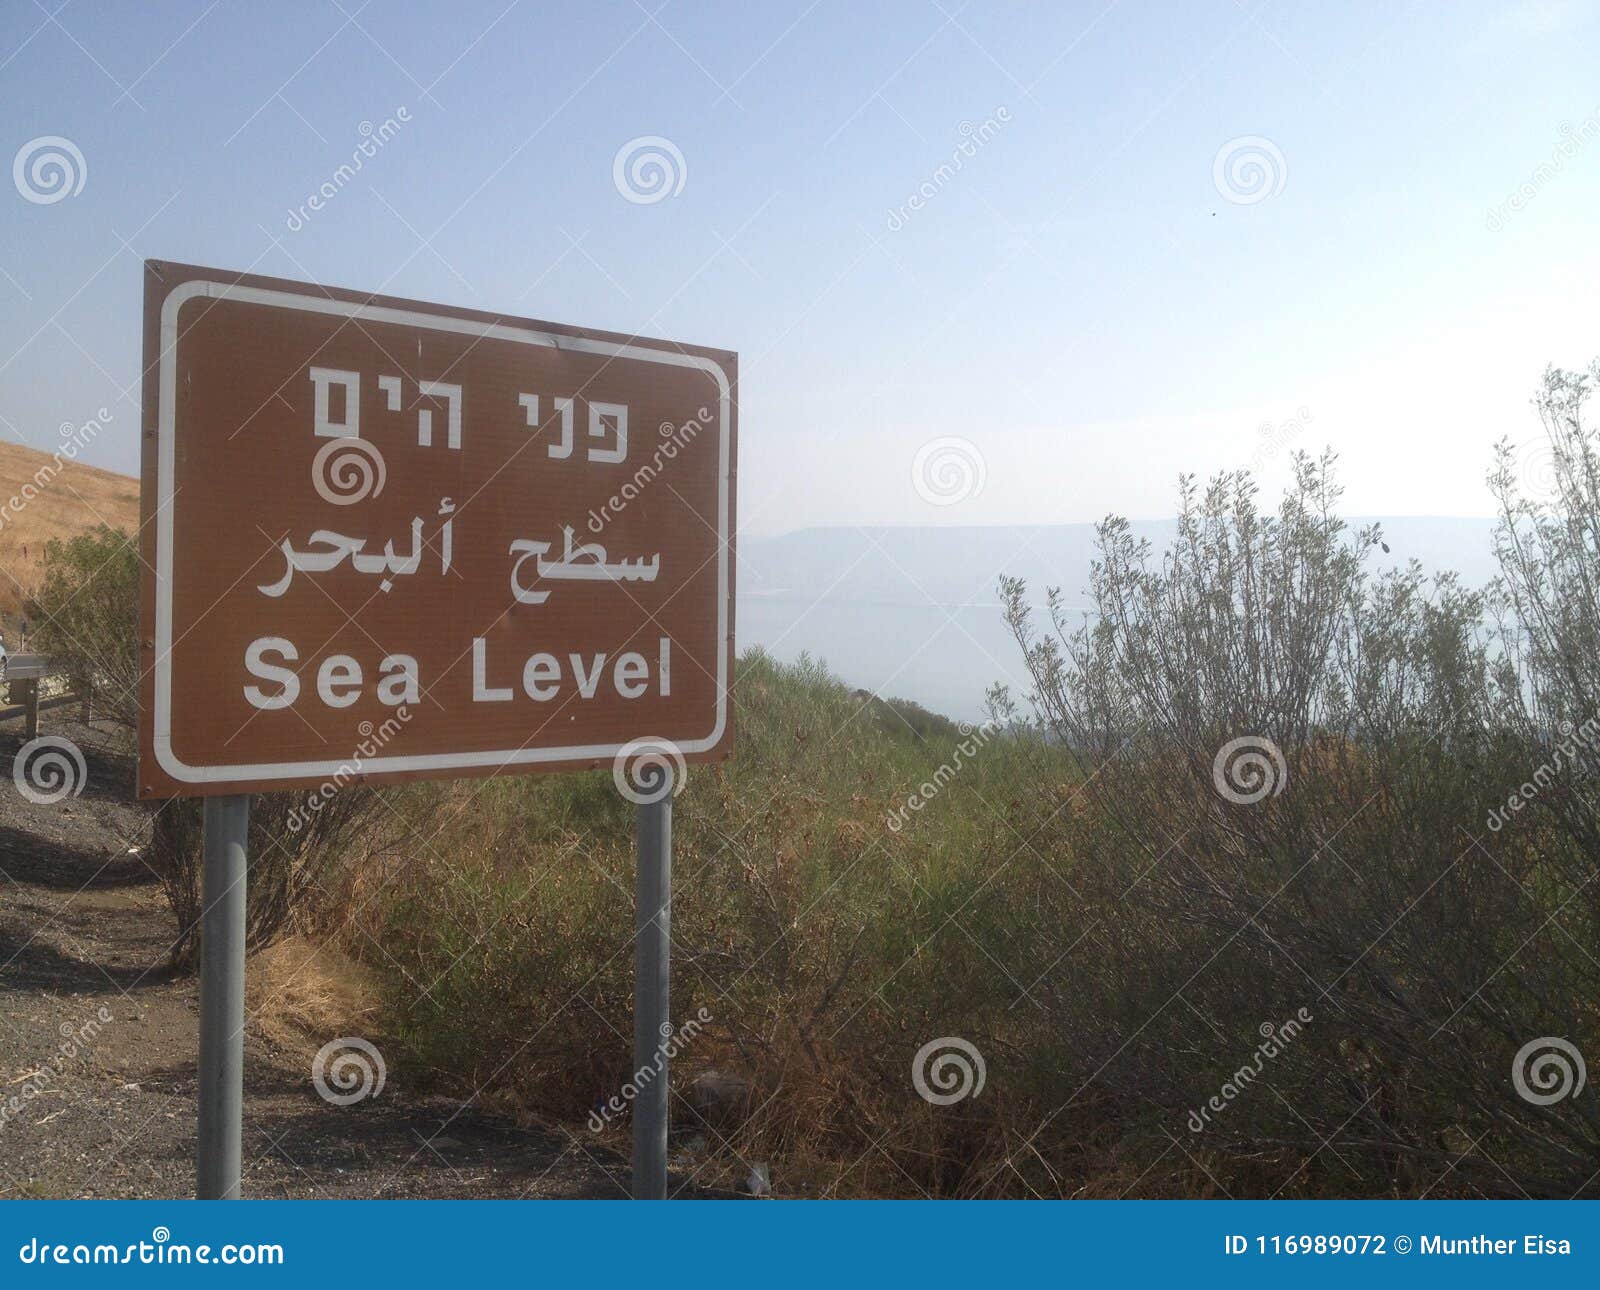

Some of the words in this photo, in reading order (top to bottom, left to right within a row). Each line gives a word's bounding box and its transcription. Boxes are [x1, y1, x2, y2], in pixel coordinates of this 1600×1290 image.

[309, 365, 463, 450] הים
[518, 391, 630, 464] פני
[508, 524, 661, 604] سطح
[243, 636, 421, 710] Sea
[472, 636, 671, 702] Level
